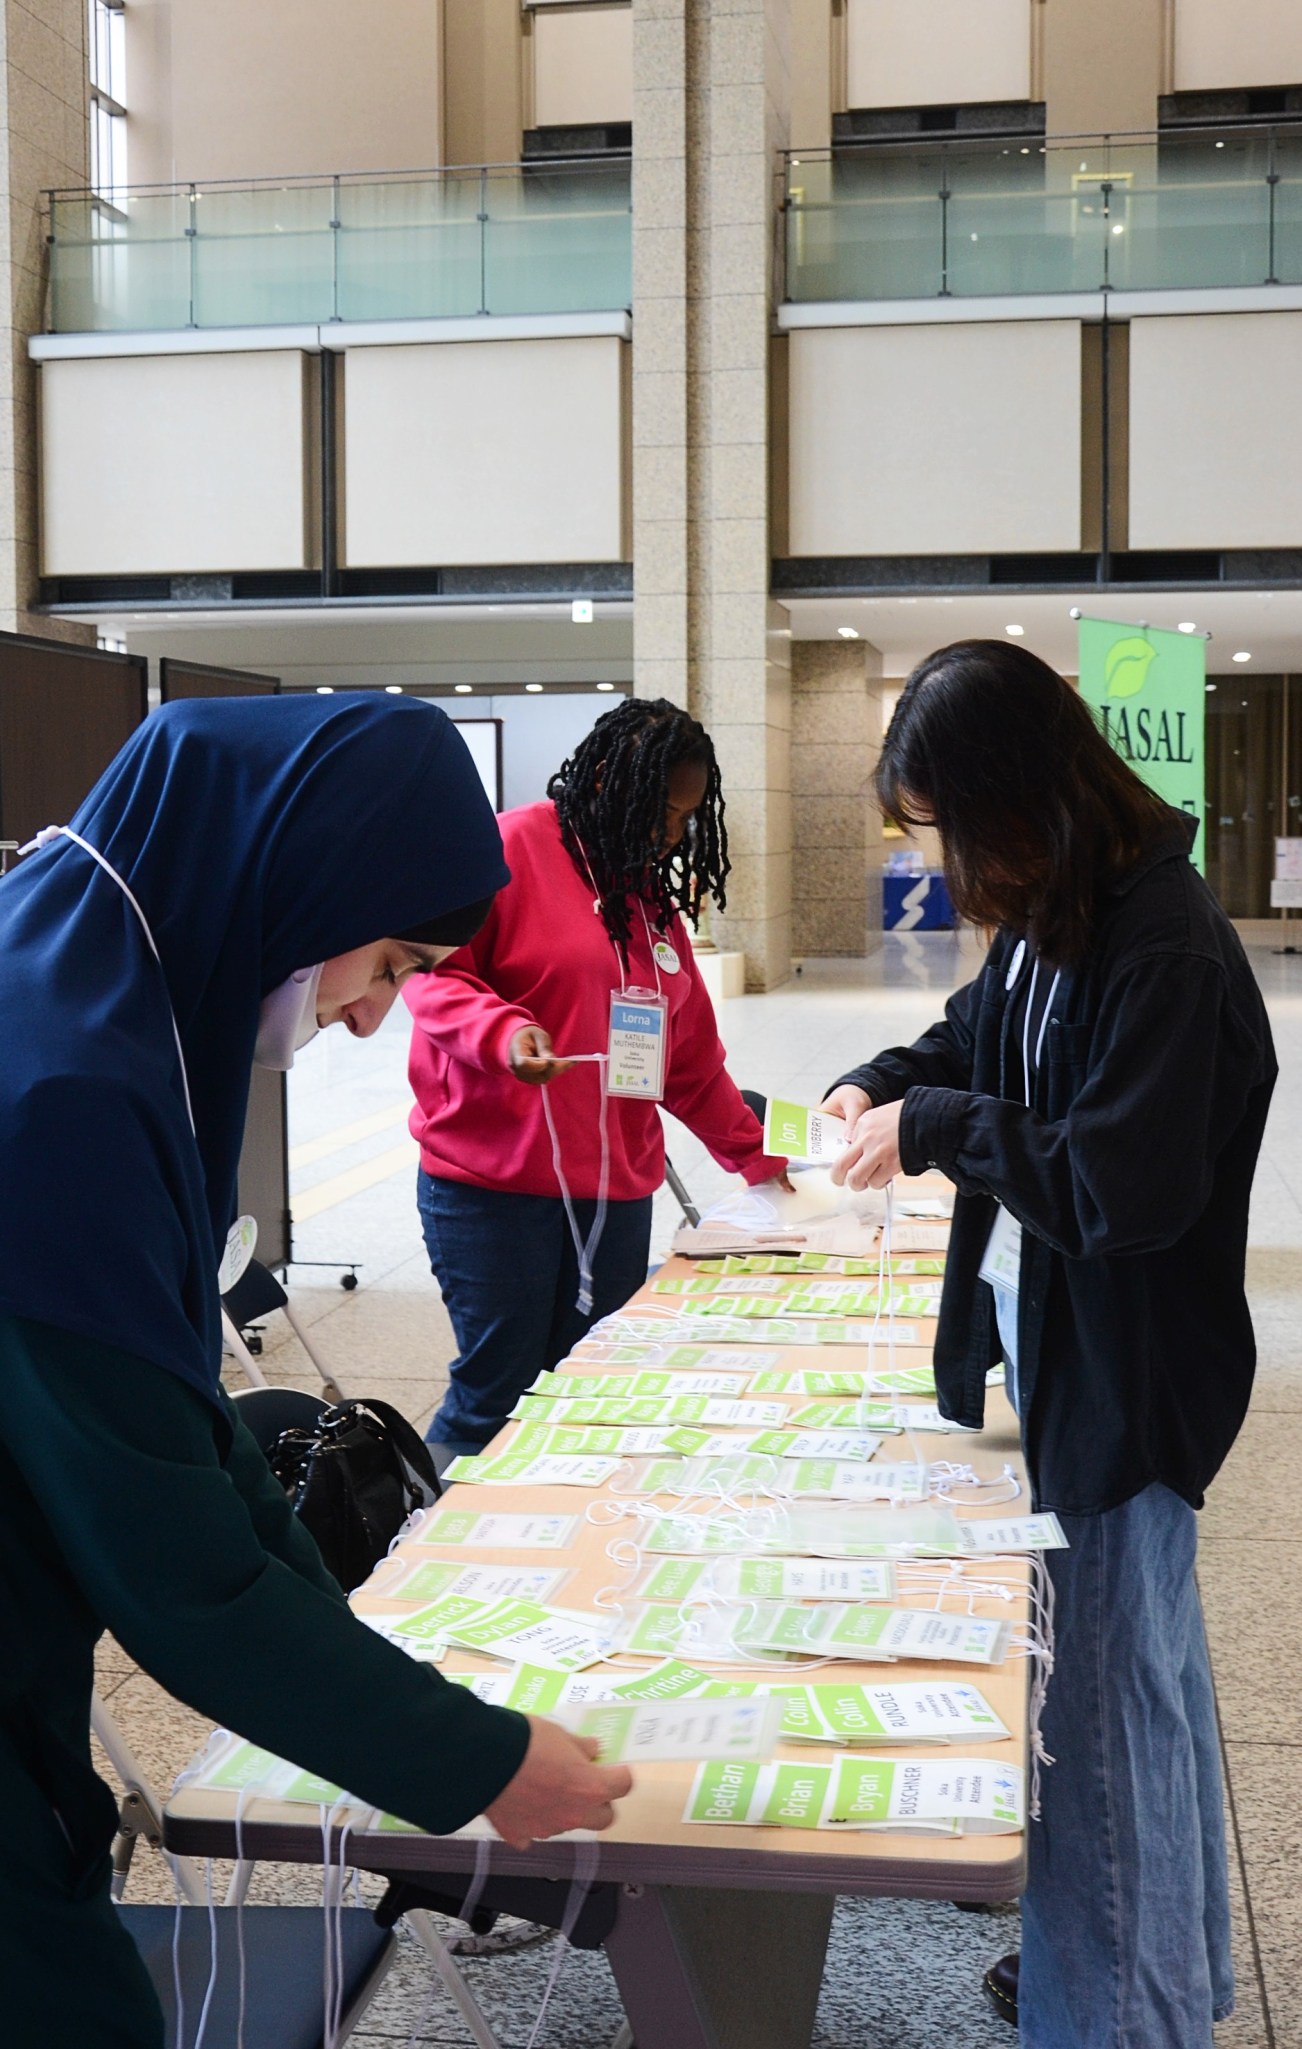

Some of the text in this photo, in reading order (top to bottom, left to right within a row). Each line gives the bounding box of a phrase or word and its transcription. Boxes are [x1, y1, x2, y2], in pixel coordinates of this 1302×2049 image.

[622, 1012, 651, 1026] Lorna
[619, 1063, 645, 1071] Volunteer
[778, 1122, 801, 1147] Jon
[406, 1600, 473, 1636] Derrick
[467, 1614, 532, 1642] Dylan
[845, 1613, 877, 1638] Ewen
[508, 1625, 553, 1645] TONG
[515, 1675, 547, 1714] Chikako
[941, 1692, 960, 1718] Attendee
[783, 1696, 808, 1727] Colin
[842, 1697, 867, 1728] Colin
[874, 1691, 909, 1728] RUNDLE
[705, 1763, 746, 1819] Bethan
[778, 1778, 815, 1818] Brian
[850, 1773, 881, 1812] Bryan
[899, 1766, 922, 1815] BUSCHNER
[937, 1782, 949, 1796] Soka
[954, 1776, 967, 1803] University
[970, 1775, 982, 1803] Attendee
